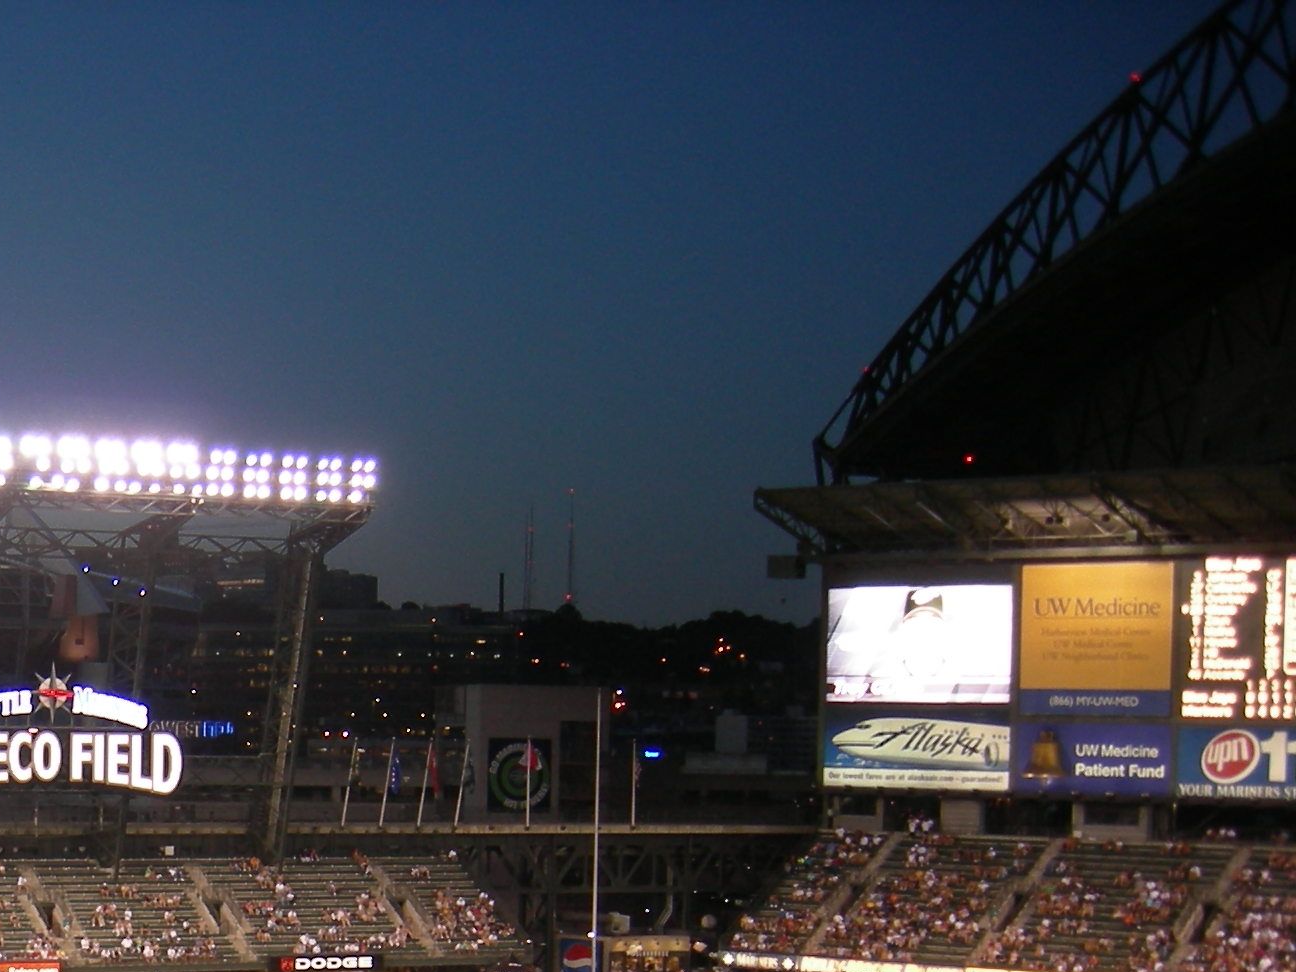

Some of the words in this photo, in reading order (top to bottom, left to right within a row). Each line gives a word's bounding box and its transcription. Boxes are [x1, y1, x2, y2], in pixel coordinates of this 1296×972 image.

[1034, 598, 1071, 616] UW
[1075, 597, 1161, 617] Medicine
[872, 722, 982, 757] Alaska
[1075, 744, 1099, 757] UW
[1101, 745, 1159, 758] Medicine
[1207, 737, 1250, 772] upn
[1260, 731, 1296, 783] 1
[68, 729, 184, 796] FIELD
[1075, 763, 1125, 777] Patient
[1129, 765, 1165, 779] Fund
[1178, 784, 1212, 796] YOUR
[1216, 785, 1280, 799] MARINERS
[295, 955, 373, 970] DODGE
